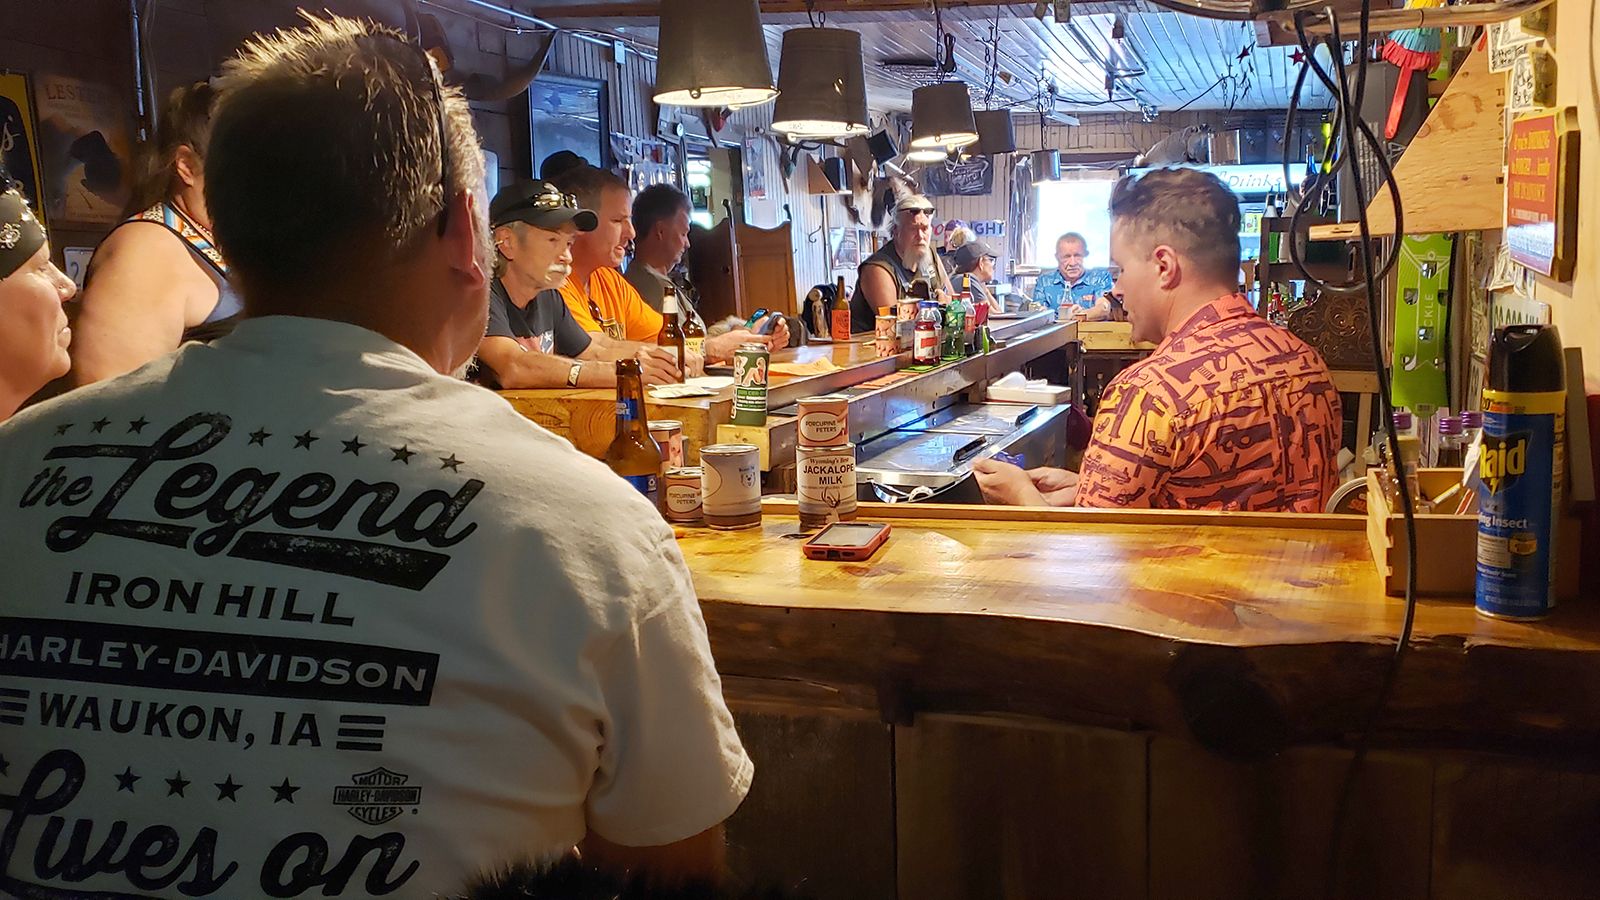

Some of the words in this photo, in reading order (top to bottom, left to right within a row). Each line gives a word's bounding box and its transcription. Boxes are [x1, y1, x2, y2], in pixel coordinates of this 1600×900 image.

[1228, 174, 1282, 187] Drinks
[970, 222, 1005, 235] IGHT
[803, 463, 854, 475] JACKALOPE
[809, 457, 839, 466] Wyoming's
[20, 466, 94, 508] the
[43, 411, 485, 557] Legend
[818, 475, 843, 485] MILK
[1492, 515, 1528, 529] Insect
[66, 572, 204, 614] IRON
[214, 583, 355, 627] HILL
[39, 692, 256, 750] WAUKON,
[270, 711, 322, 748] IA
[359, 771, 400, 786] MOTOR
[354, 806, 397, 822] CYCLES
[0, 749, 238, 900] Lives
[260, 831, 420, 898] on
